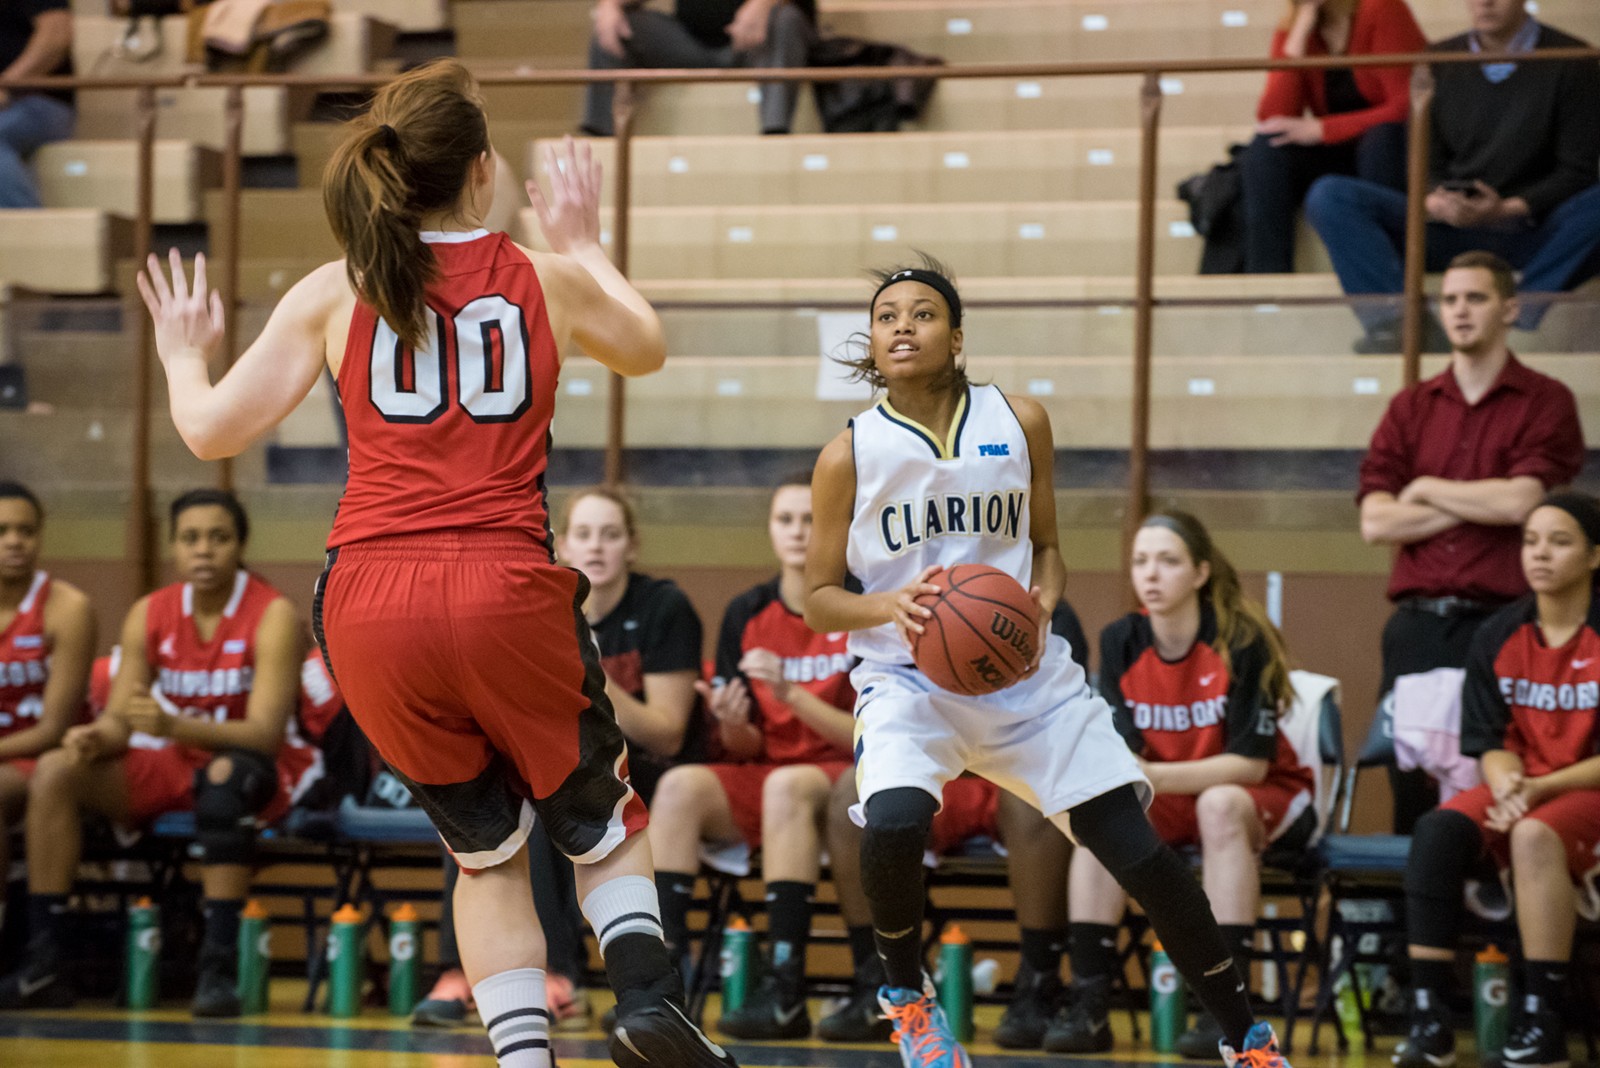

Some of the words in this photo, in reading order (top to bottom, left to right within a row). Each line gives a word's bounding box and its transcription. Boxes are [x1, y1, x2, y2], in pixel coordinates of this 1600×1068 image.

[368, 293, 533, 424] 00
[877, 489, 1028, 555] CLARION
[390, 931, 415, 961] G
[1152, 965, 1178, 994] G
[1480, 978, 1508, 1007] G
